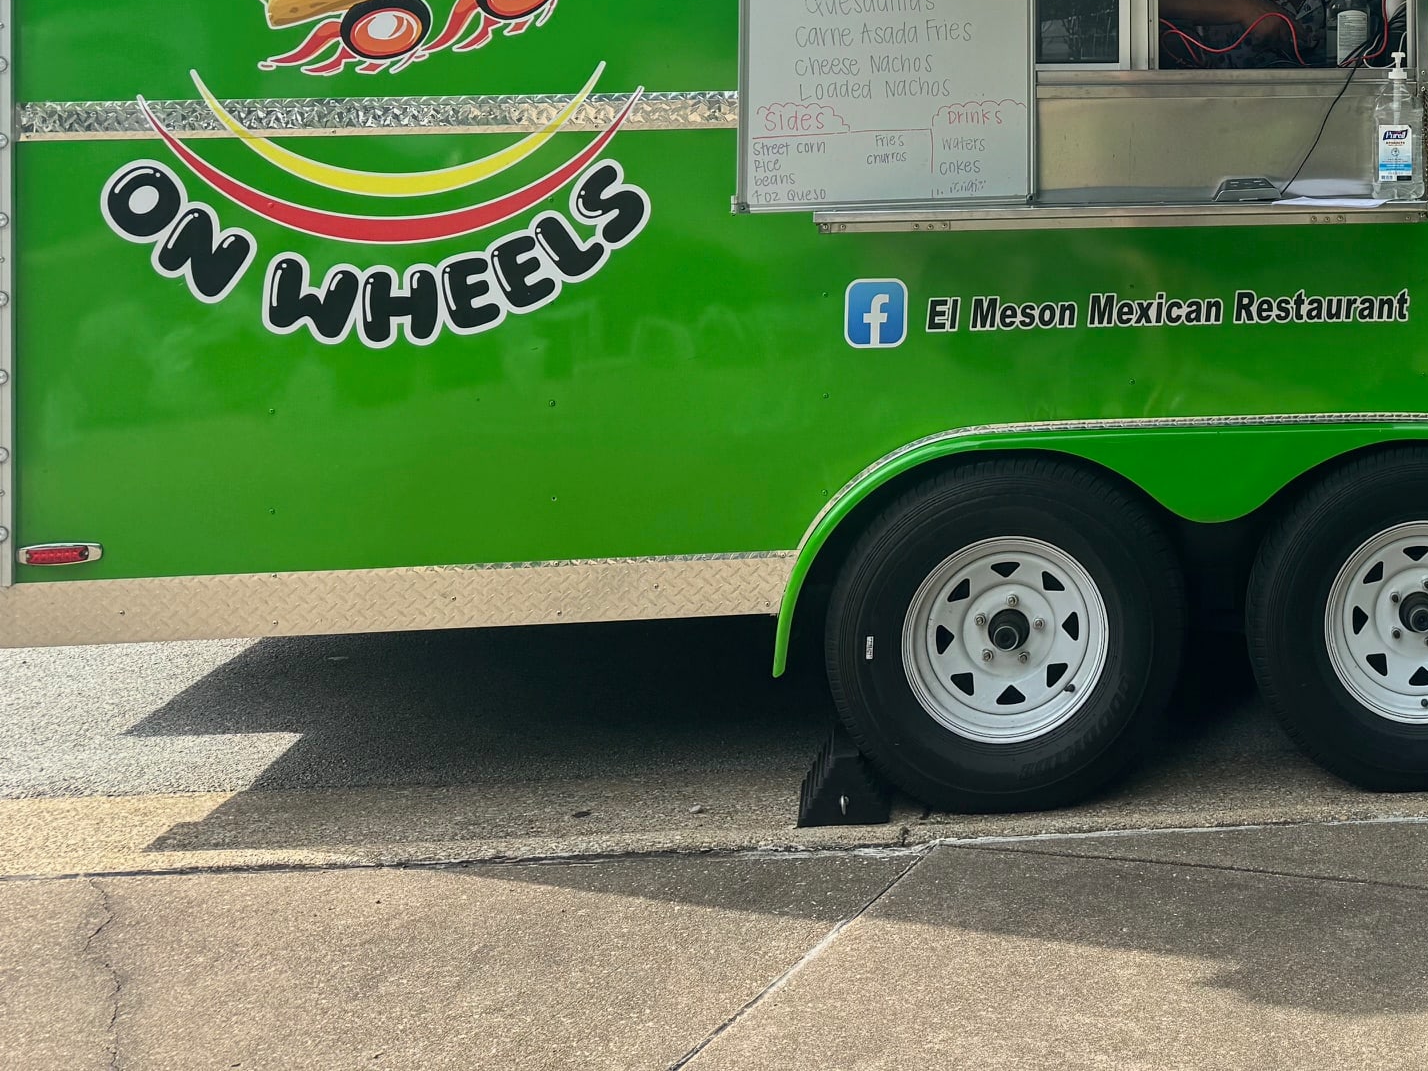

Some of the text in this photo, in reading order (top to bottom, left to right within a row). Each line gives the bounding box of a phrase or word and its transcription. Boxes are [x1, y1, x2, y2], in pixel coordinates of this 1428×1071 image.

[861, 22, 918, 44] Asada
[925, 18, 972, 42] Fries
[870, 53, 933, 74] Nachos
[800, 76, 951, 101] Loaded Nachos
[764, 110, 825, 131] Sides
[947, 109, 1003, 125] Drinks
[752, 141, 791, 156] Street
[875, 134, 905, 147] Fries
[754, 158, 782, 173] Rice
[754, 172, 796, 187] beans
[787, 188, 827, 202] Queso
[102, 160, 652, 348] ON WHEELS
[926, 287, 1410, 333] El Meson Mexican Restaurant
